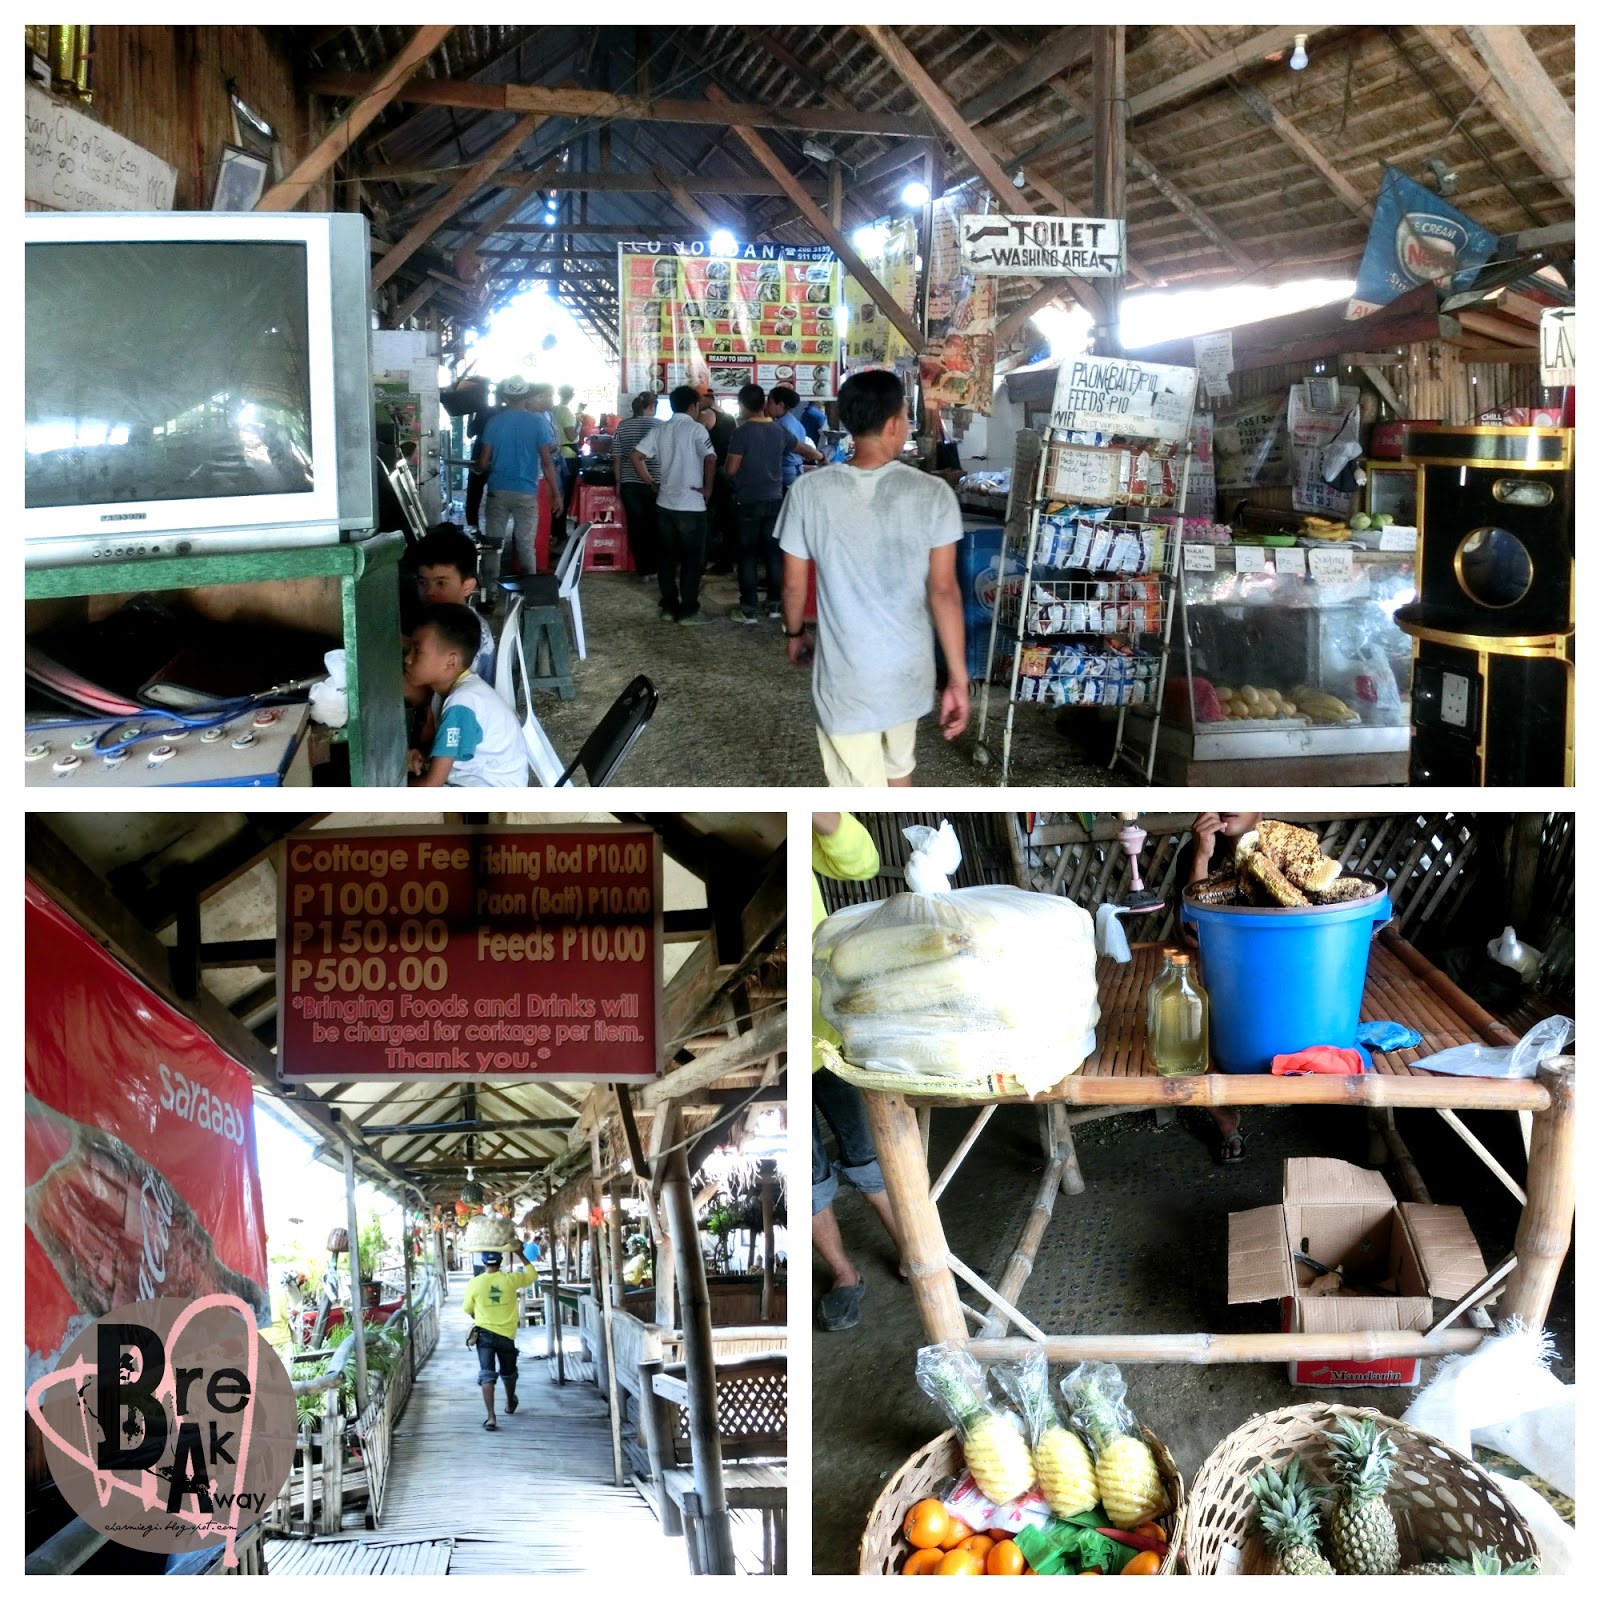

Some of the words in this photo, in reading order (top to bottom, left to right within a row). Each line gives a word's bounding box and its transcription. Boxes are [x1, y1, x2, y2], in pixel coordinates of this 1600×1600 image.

[1010, 221, 1106, 247] TOILET
[1421, 222, 1457, 239] CREAM
[991, 248, 1058, 267] WASHING
[1062, 250, 1099, 267] AREA
[1481, 413, 1502, 421] CHILL
[290, 844, 409, 878] Cottage
[417, 843, 470, 871] Fee
[546, 844, 583, 874] Rod
[587, 843, 647, 874] P10.00
[293, 881, 449, 917] P100.00
[588, 886, 651, 915] P10.00
[293, 918, 449, 954] P150.00
[477, 926, 555, 962] Feeds
[562, 926, 646, 962] P10.00
[291, 956, 449, 993] P500.00
[400, 994, 468, 1018] Foods
[474, 993, 521, 1018] and
[527, 993, 597, 1018] Drinks
[601, 993, 640, 1018] will
[312, 1022, 340, 1043] be
[343, 1021, 430, 1046] charged
[433, 1021, 462, 1043] for
[465, 1021, 552, 1046] corkage
[555, 1024, 591, 1046] per
[594, 1021, 645, 1043] item.
[384, 1047, 470, 1070] Thank
[1330, 1370, 1402, 1382] Mandarin
